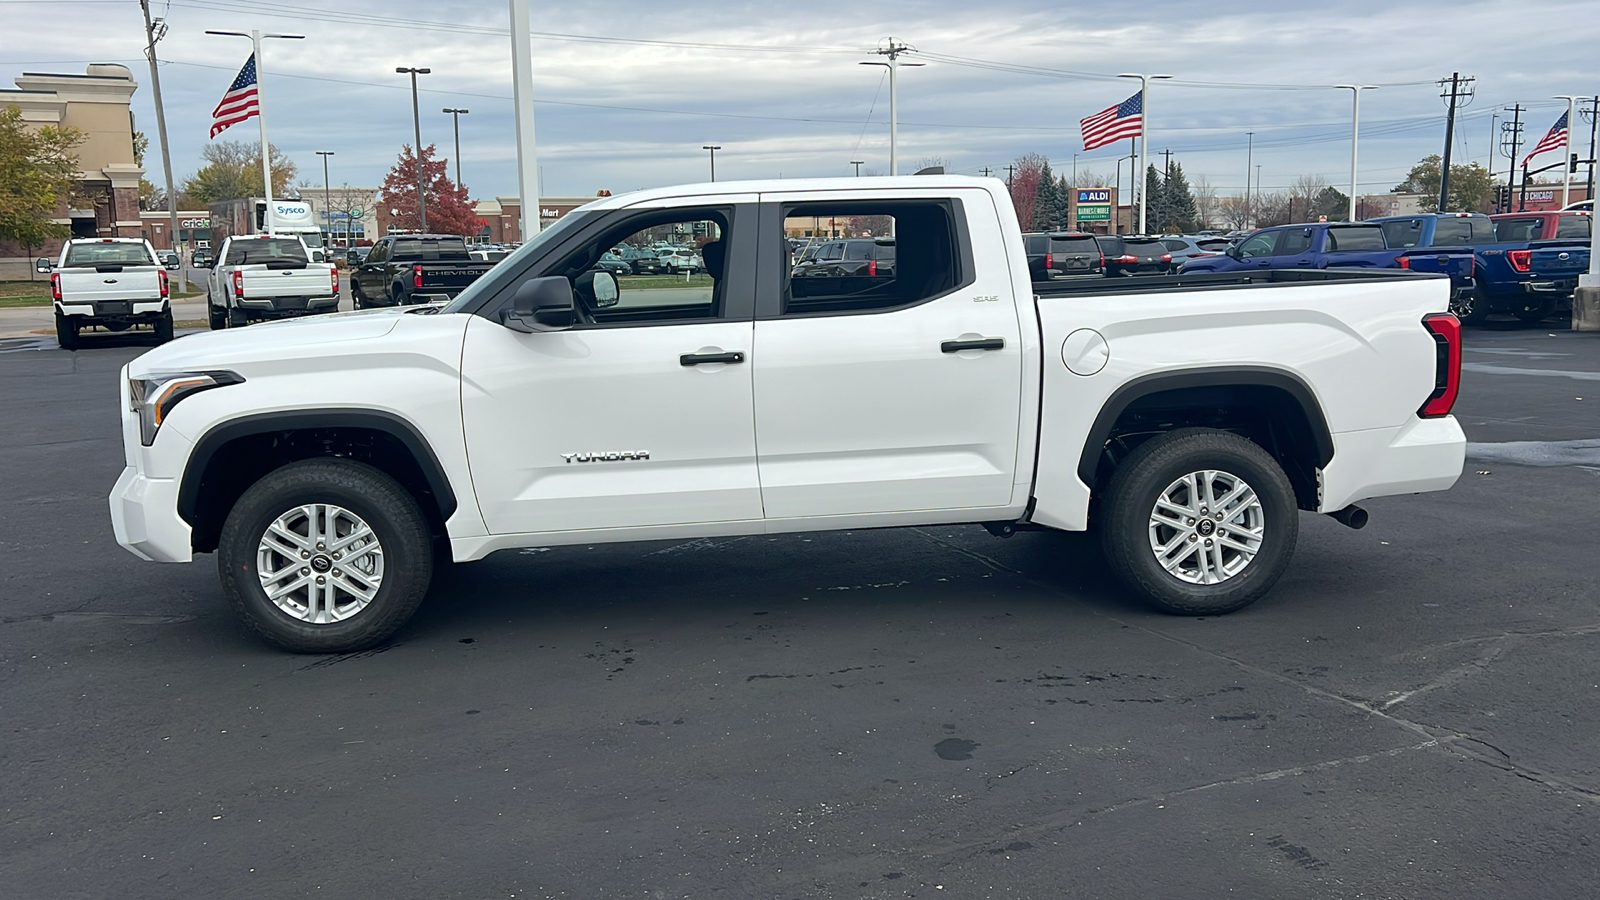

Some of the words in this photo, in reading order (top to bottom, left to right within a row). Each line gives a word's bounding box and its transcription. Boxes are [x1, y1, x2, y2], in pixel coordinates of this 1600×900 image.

[1089, 192, 1108, 200] ALDI
[1518, 192, 1529, 200] OD
[1530, 191, 1553, 200] CHICAGO
[277, 206, 305, 215] Sysco
[542, 208, 559, 217] Mart
[560, 449, 650, 463] TUNDRA
